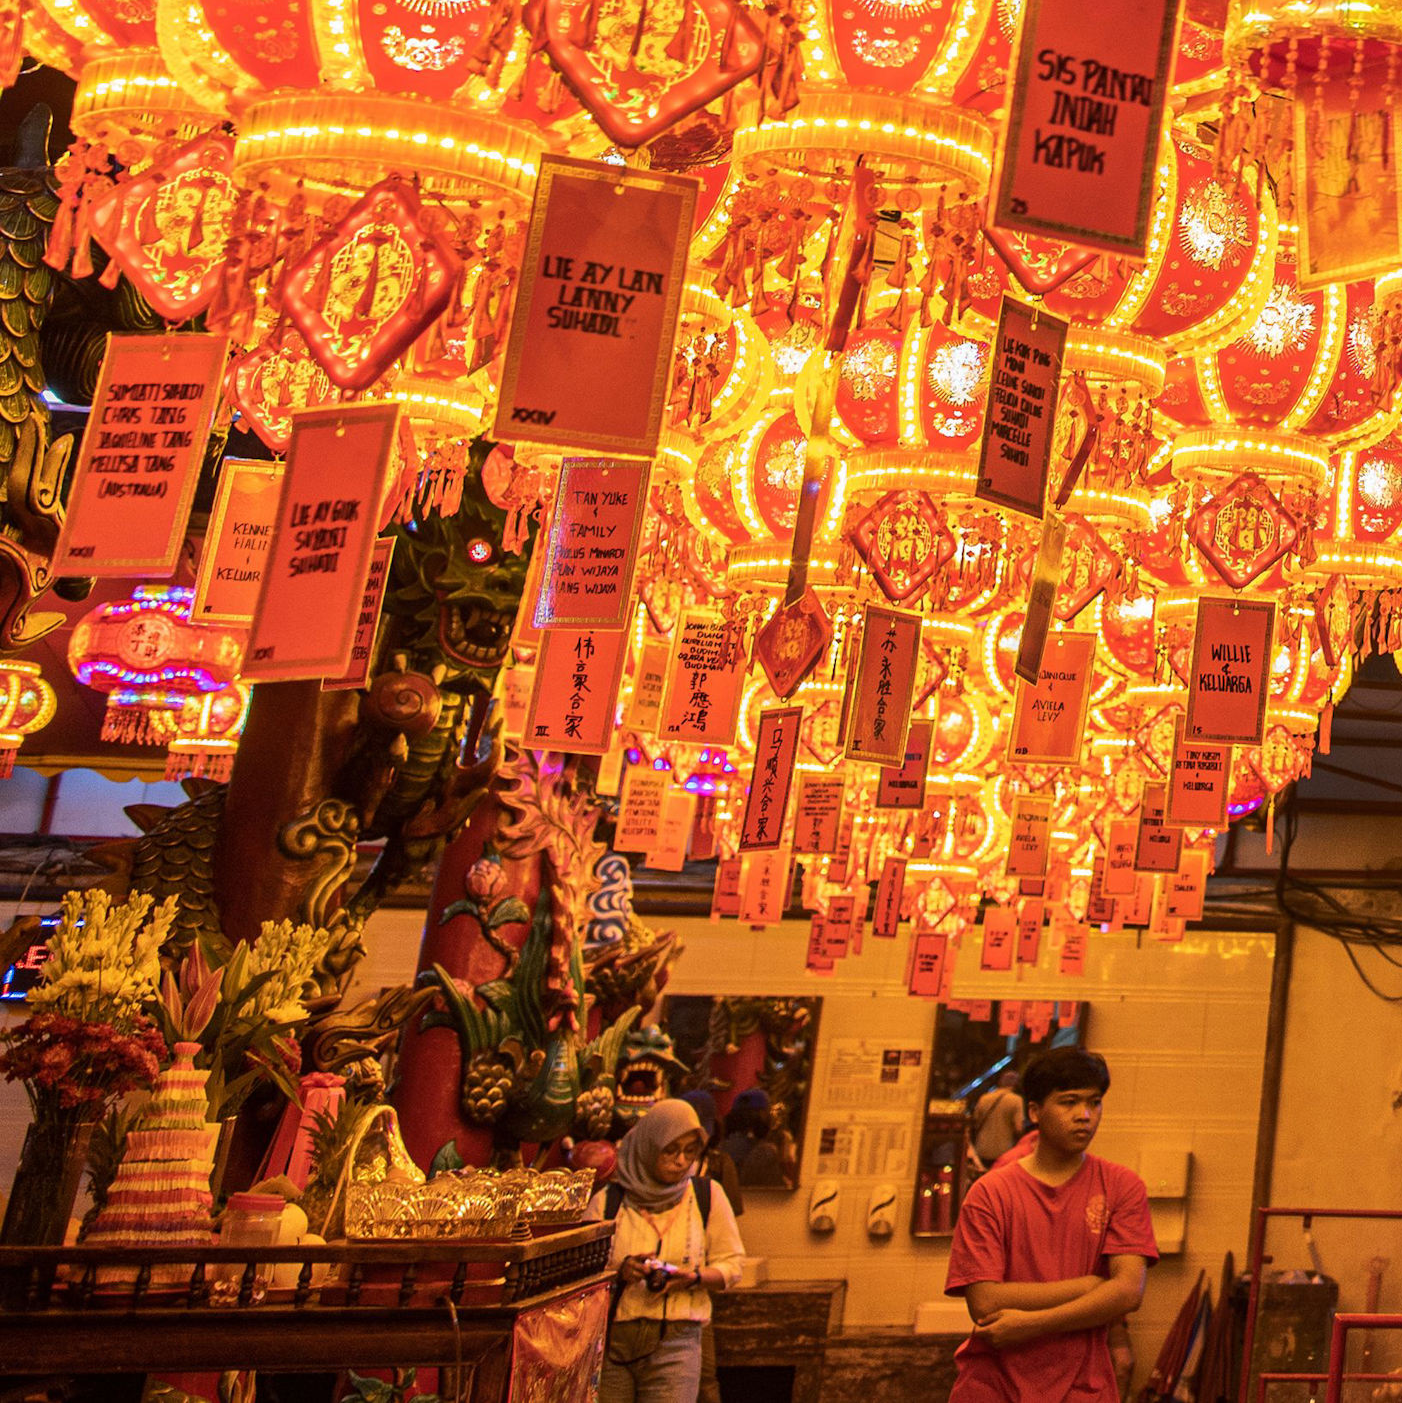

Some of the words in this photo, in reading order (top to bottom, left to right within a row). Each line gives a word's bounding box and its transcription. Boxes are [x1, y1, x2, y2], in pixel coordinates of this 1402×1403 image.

[542, 255, 575, 280] LIE
[580, 261, 614, 284] AY
[618, 267, 664, 295] LAN
[557, 284, 636, 314] LANNY
[233, 522, 272, 536] KENNE
[570, 523, 616, 538] FAMILY
[216, 568, 261, 582] KELUAR
[1212, 644, 1252, 664] WILLIE
[564, 630, 596, 740] 伟豪合家
[1199, 674, 1252, 694] KELUARGA
